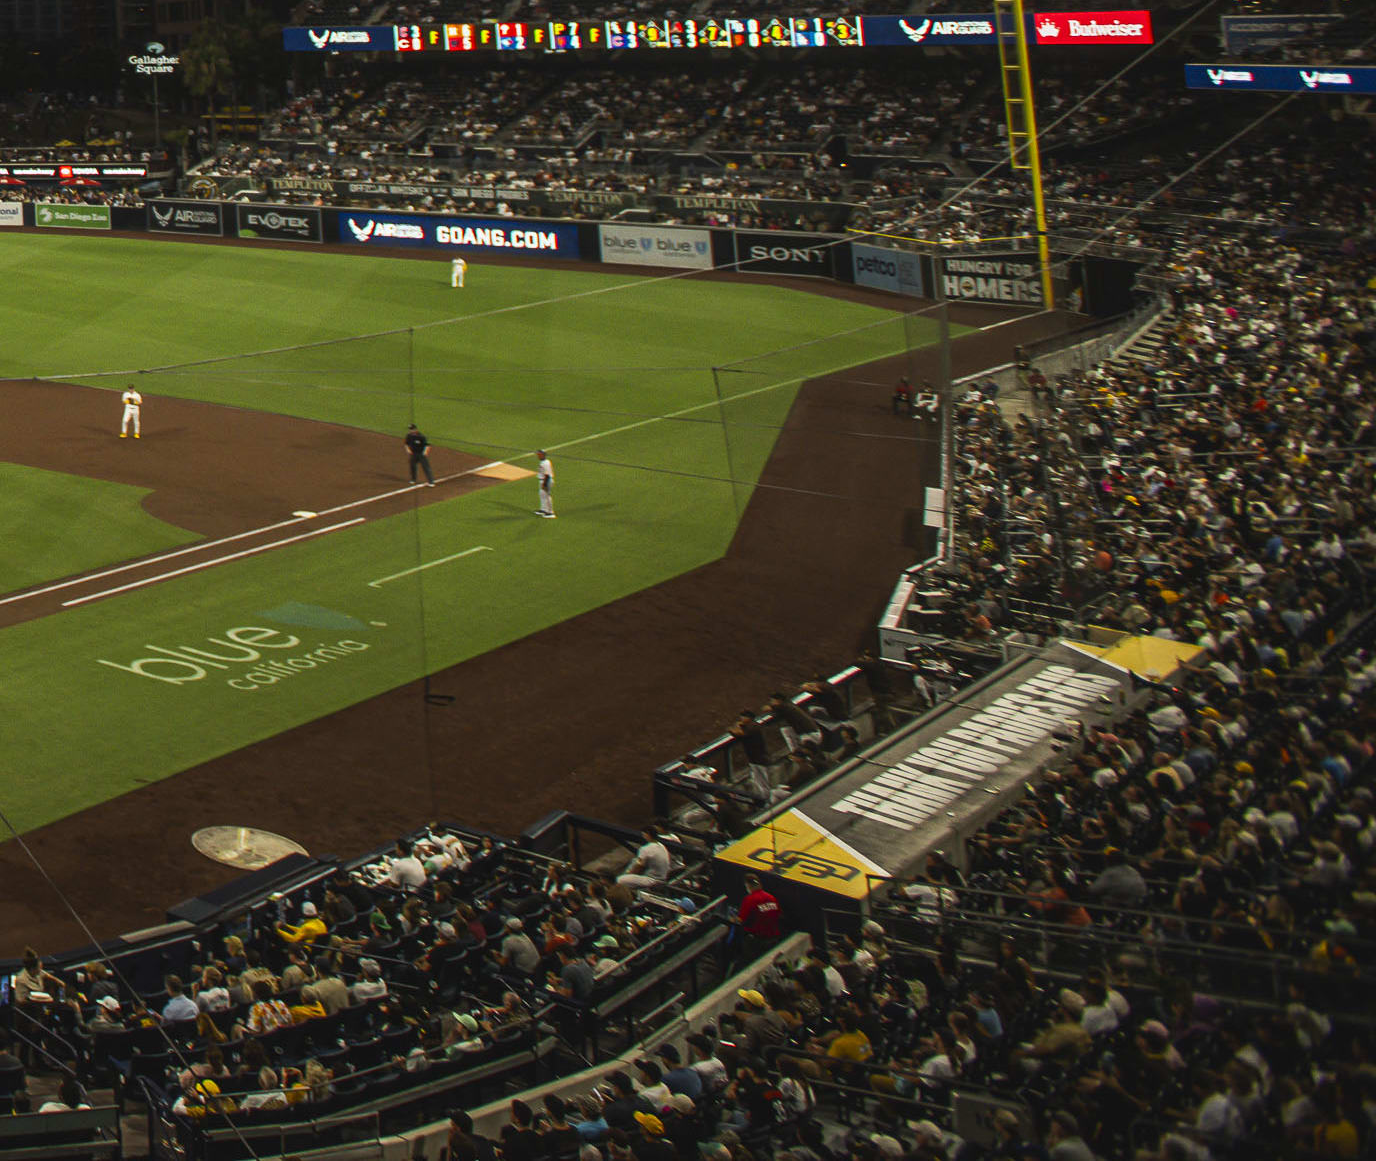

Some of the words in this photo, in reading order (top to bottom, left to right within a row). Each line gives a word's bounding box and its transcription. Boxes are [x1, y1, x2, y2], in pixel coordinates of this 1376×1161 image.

[1068, 19, 1143, 39] Budweiser
[129, 56, 180, 65] Gallagher
[136, 64, 174, 74] Square
[73, 167, 99, 176] TOYOTA
[272, 178, 334, 191] TEMPLETON
[674, 197, 760, 212] TEMPLETON
[175, 210, 194, 223] AIR
[436, 225, 558, 250] GOANG.COM
[603, 236, 637, 249] blue
[656, 238, 692, 251] blue
[751, 245, 827, 264] SONY
[856, 256, 896, 277] petco
[948, 259, 1003, 275] HUNGRY
[1006, 262, 1033, 276] FOR
[944, 275, 1043, 302] HOMERS
[97, 626, 300, 685] blue
[227, 638, 370, 690] california
[1016, 664, 1121, 708] FANS
[946, 692, 1081, 755] PADRES
[903, 736, 1012, 781] YOU
[830, 762, 974, 832] THANK
